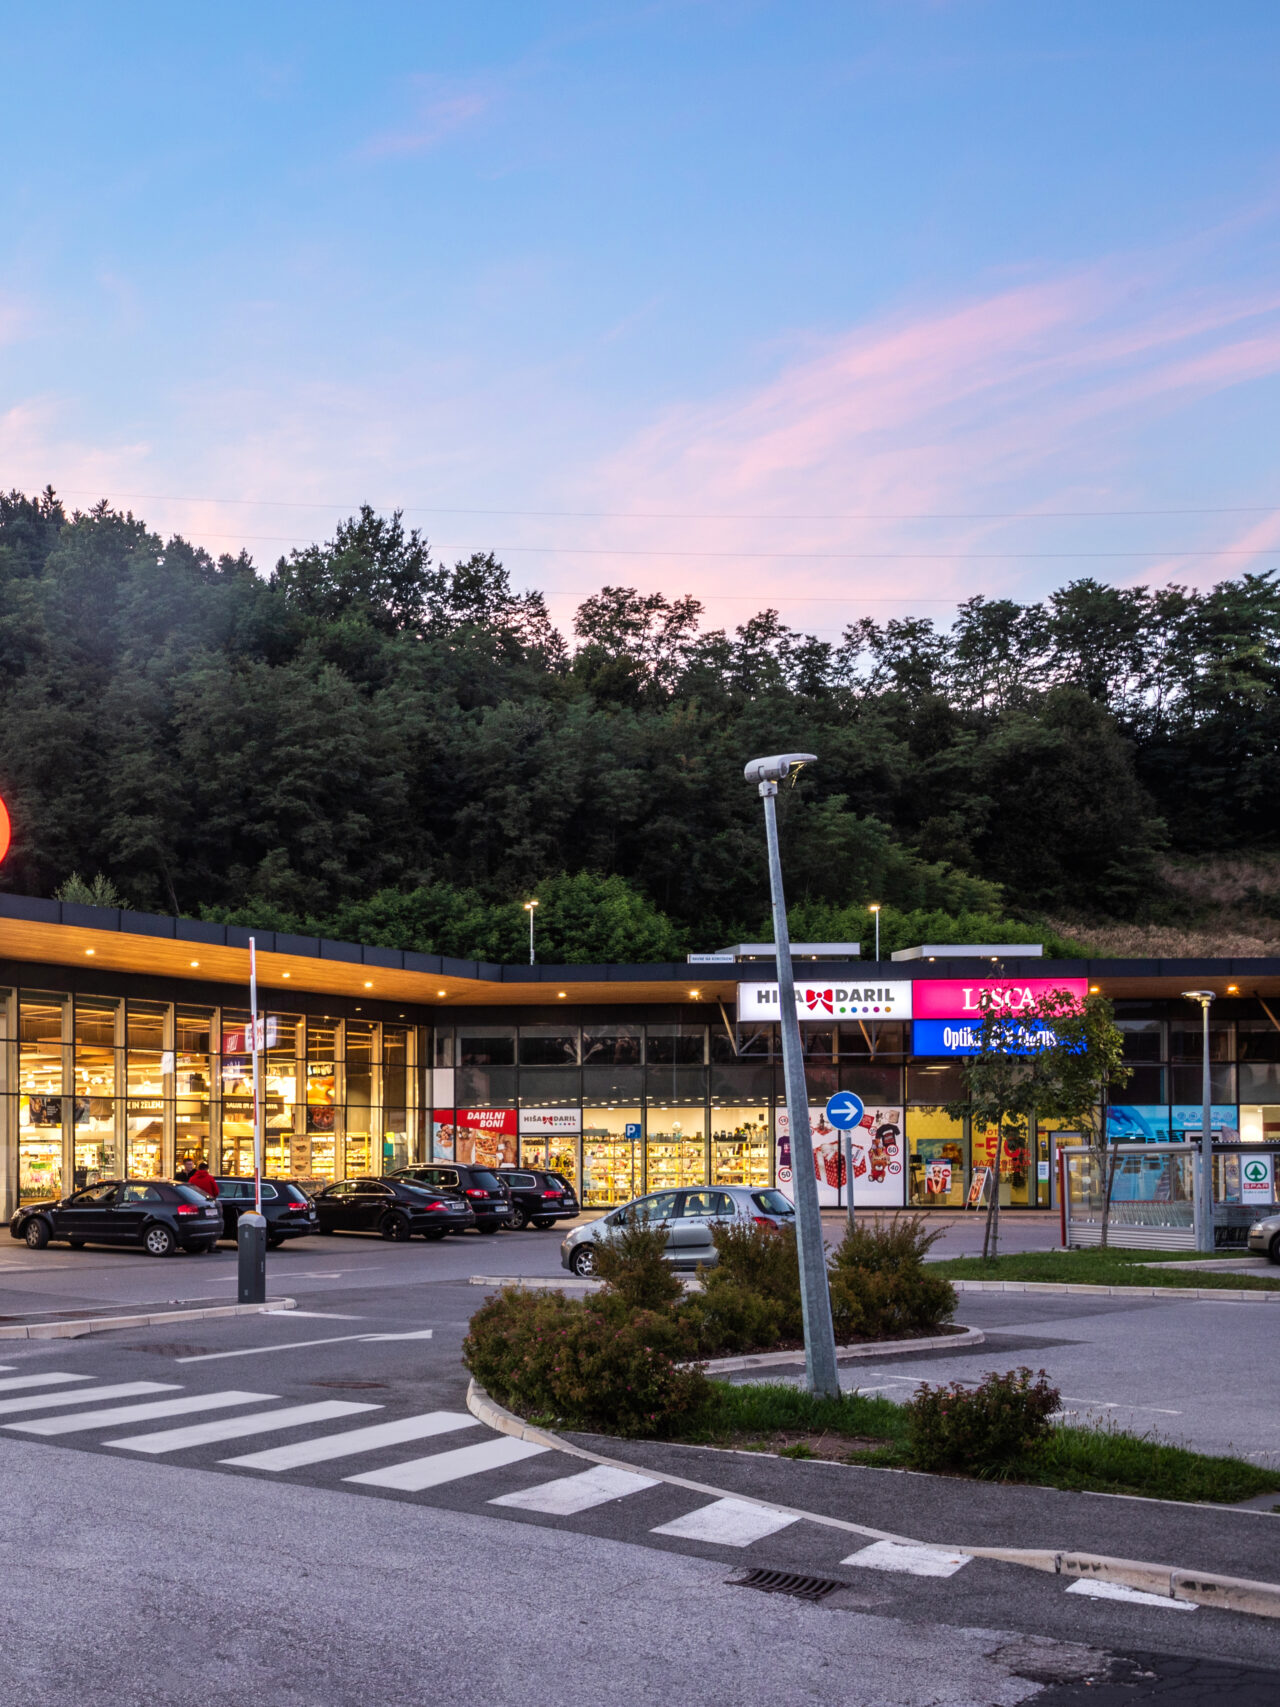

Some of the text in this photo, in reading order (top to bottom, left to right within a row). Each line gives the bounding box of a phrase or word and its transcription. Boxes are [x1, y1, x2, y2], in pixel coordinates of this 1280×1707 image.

[757, 988, 895, 1003] HIA DARIL
[467, 1111, 506, 1120] DARILNI
[523, 1114, 542, 1122] HIŠA
[480, 1120, 504, 1128] BONI
[626, 1125, 636, 1136] P
[781, 1170, 791, 1179] 50
